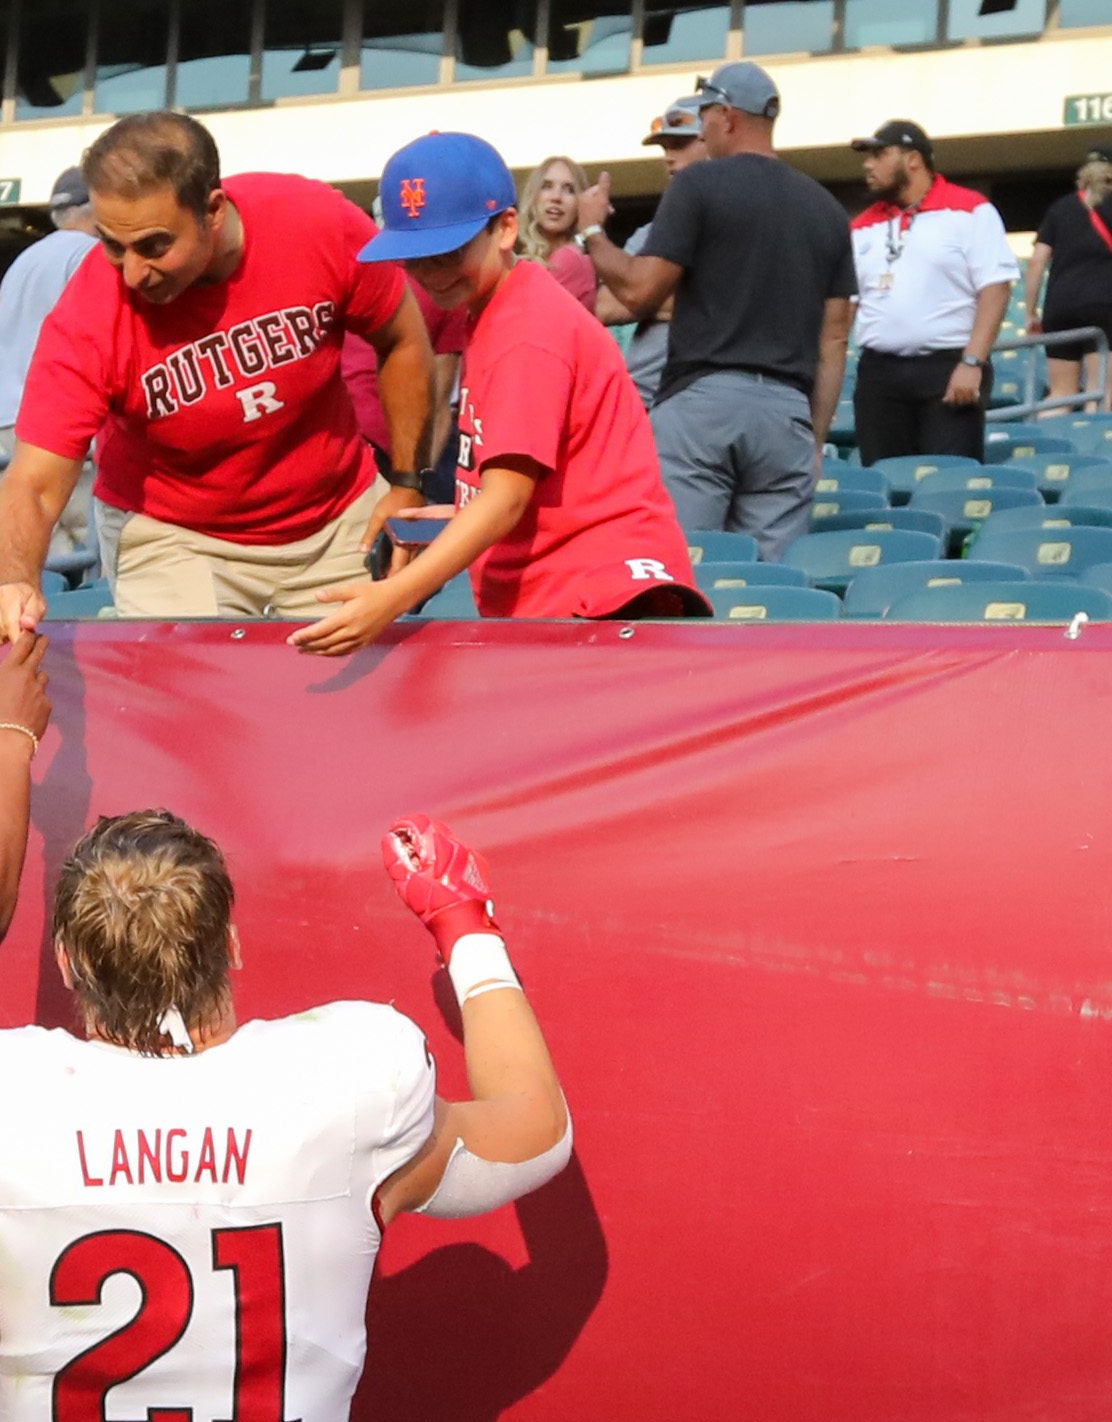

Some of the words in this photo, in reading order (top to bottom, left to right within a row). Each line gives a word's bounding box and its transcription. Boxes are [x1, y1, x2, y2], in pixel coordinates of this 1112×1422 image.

[141, 301, 335, 419] RUTGERS
[236, 381, 285, 423] R
[624, 558, 675, 581] R
[76, 1127, 253, 1188] LANGAN
